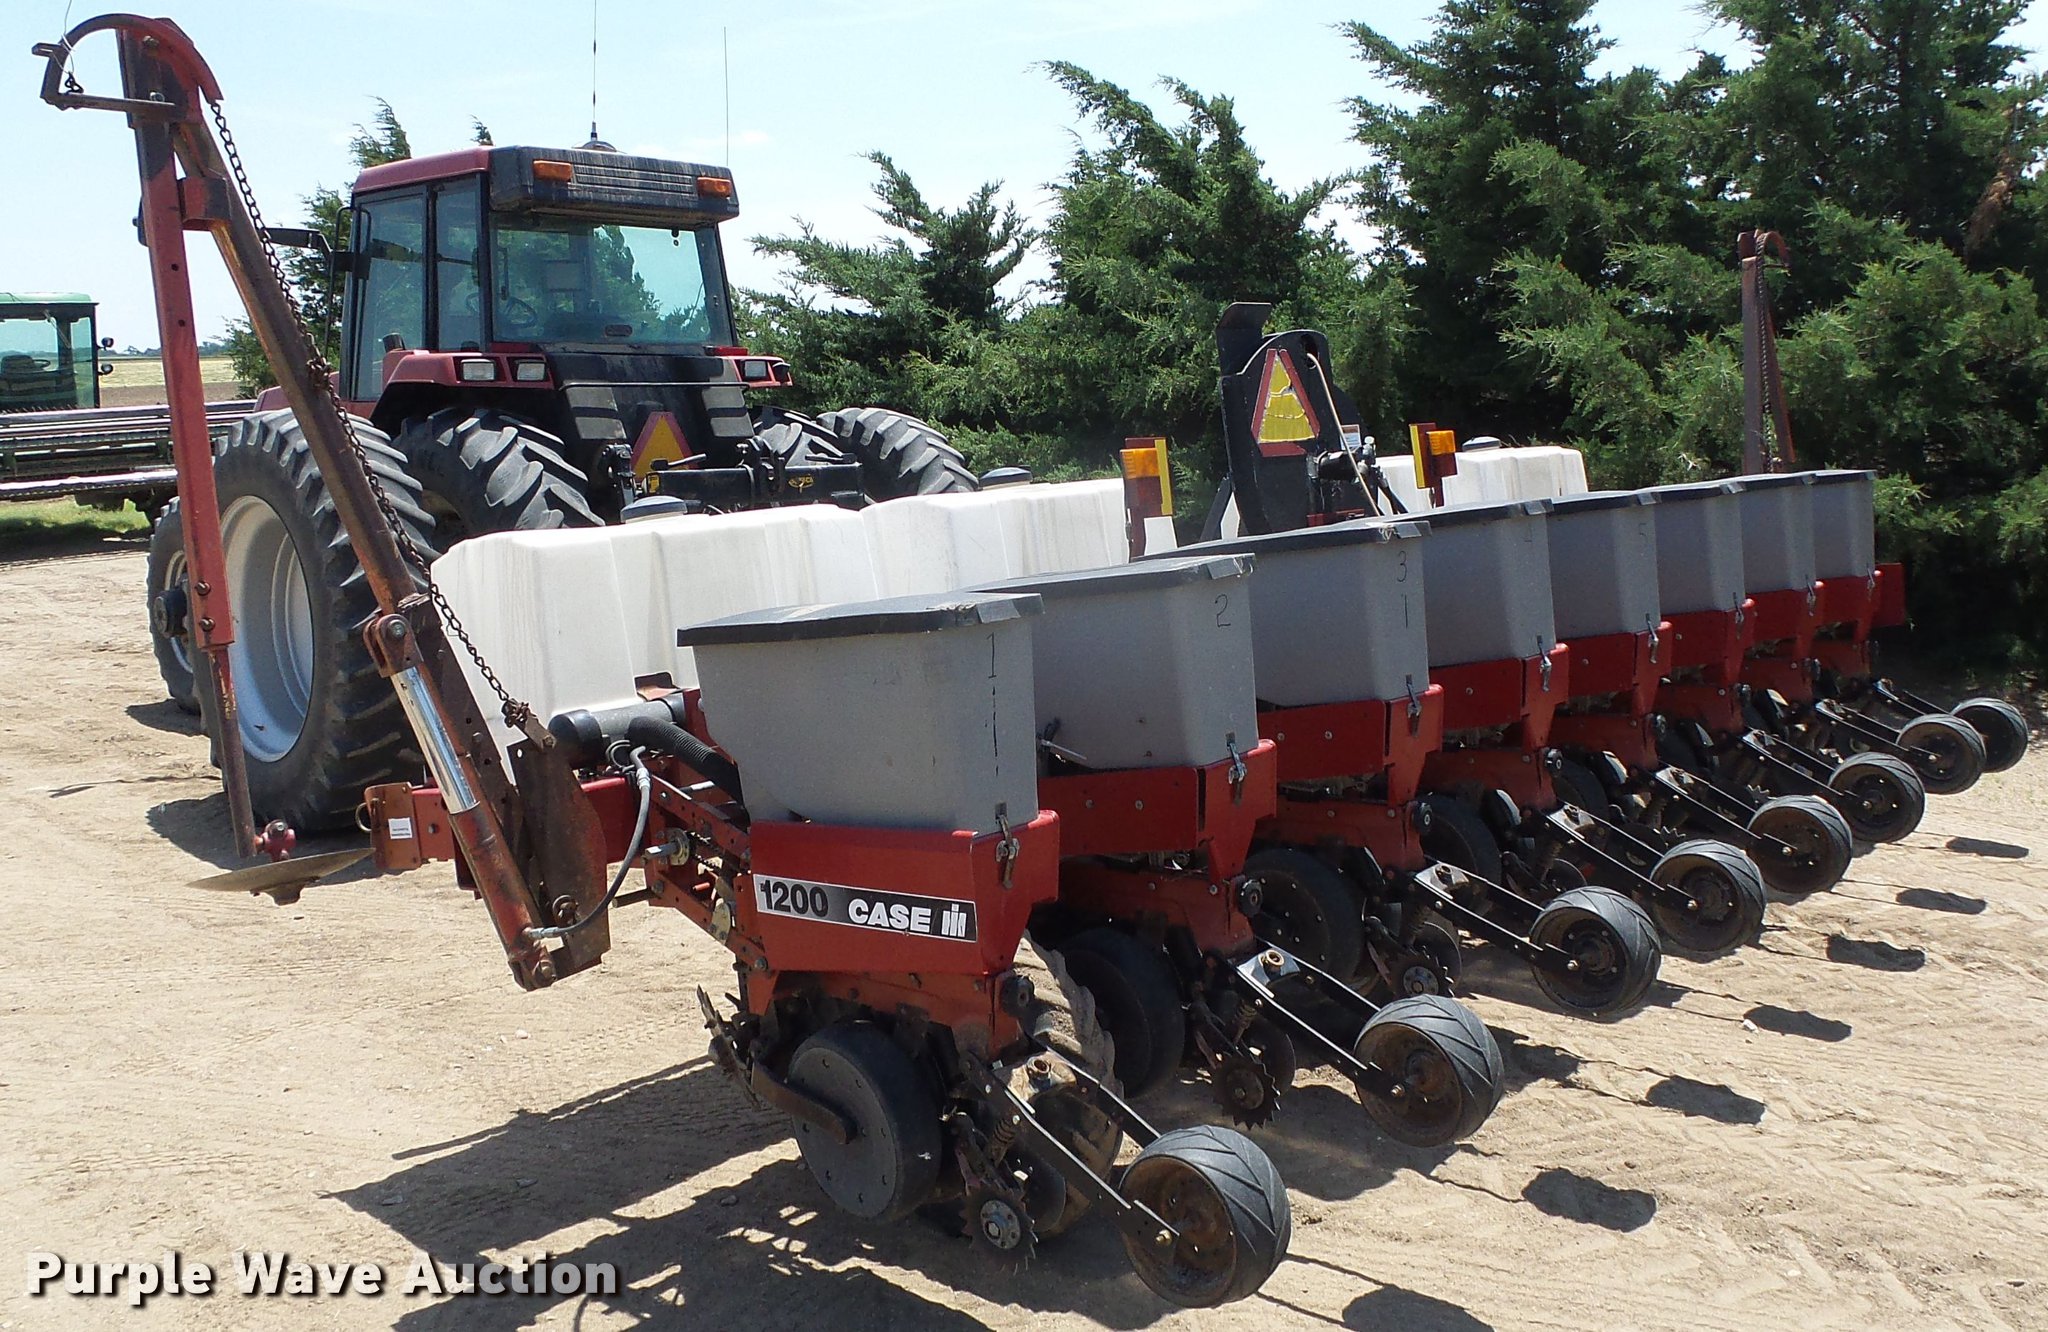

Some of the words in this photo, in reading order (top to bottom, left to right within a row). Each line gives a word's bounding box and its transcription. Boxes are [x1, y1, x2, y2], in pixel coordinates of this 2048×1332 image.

[1396, 550, 1408, 582] 3
[1214, 593, 1231, 627] 2
[760, 879, 829, 918] 1200
[848, 898, 932, 933] CASE
